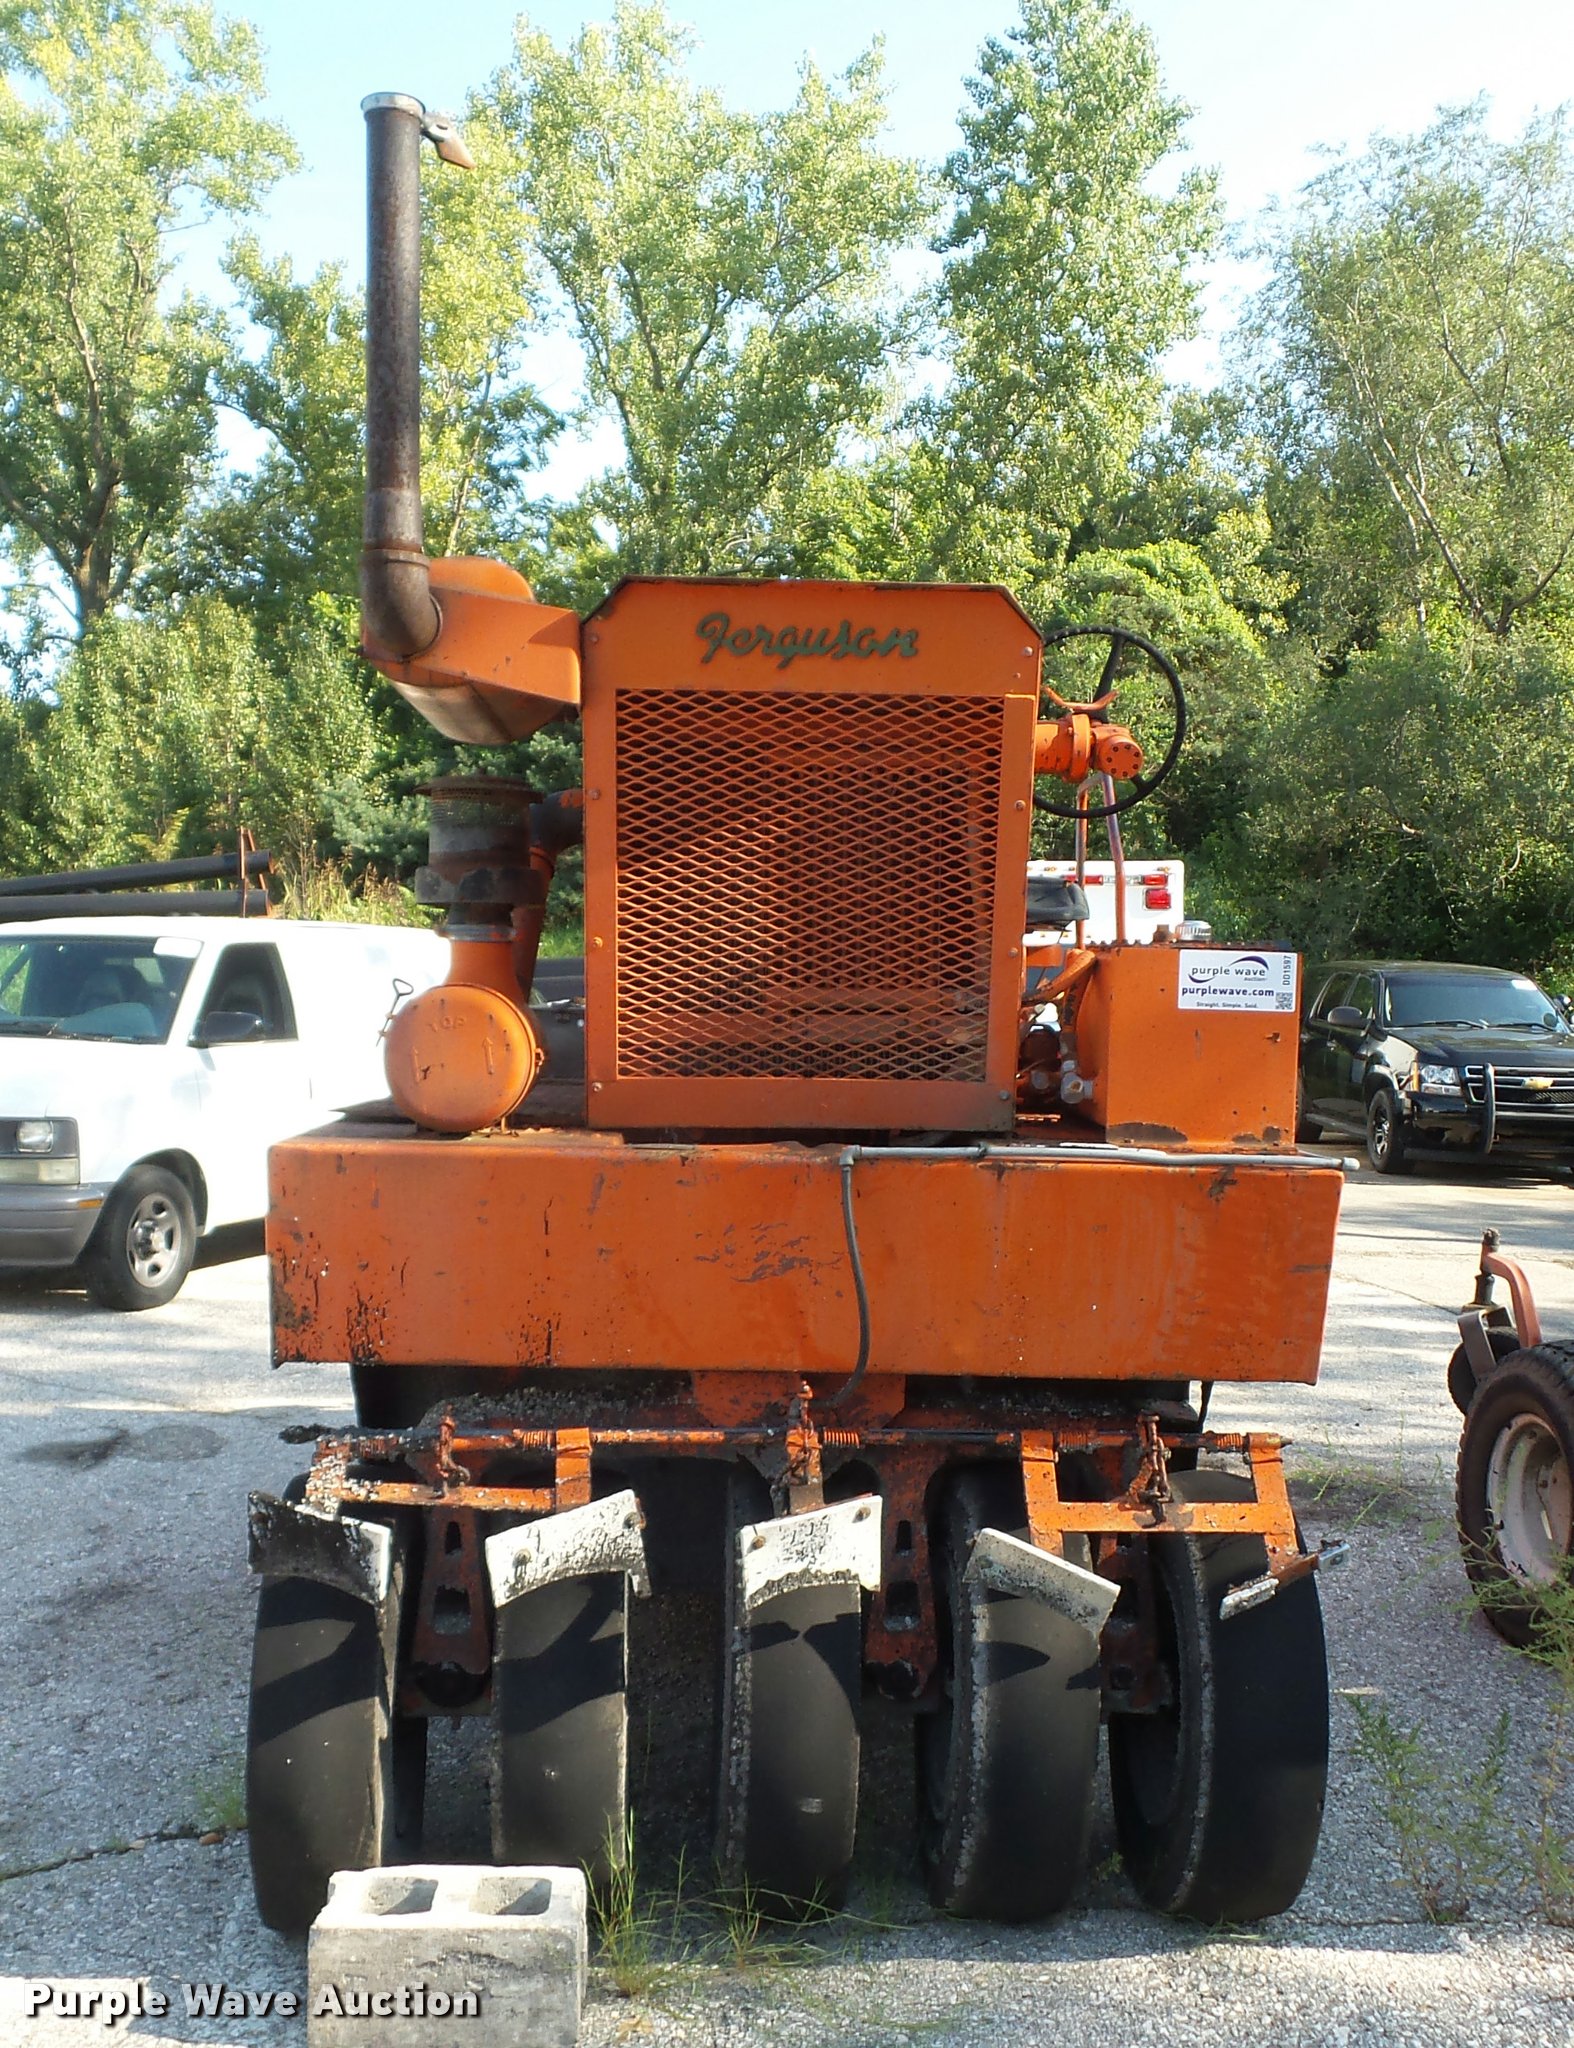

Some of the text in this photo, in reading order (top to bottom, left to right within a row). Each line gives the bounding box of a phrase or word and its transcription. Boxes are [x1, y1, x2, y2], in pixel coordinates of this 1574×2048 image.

[696, 611, 919, 670] Ferguson
[1191, 966, 1266, 976] purple wave
[1182, 985, 1275, 997] purplewave.com
